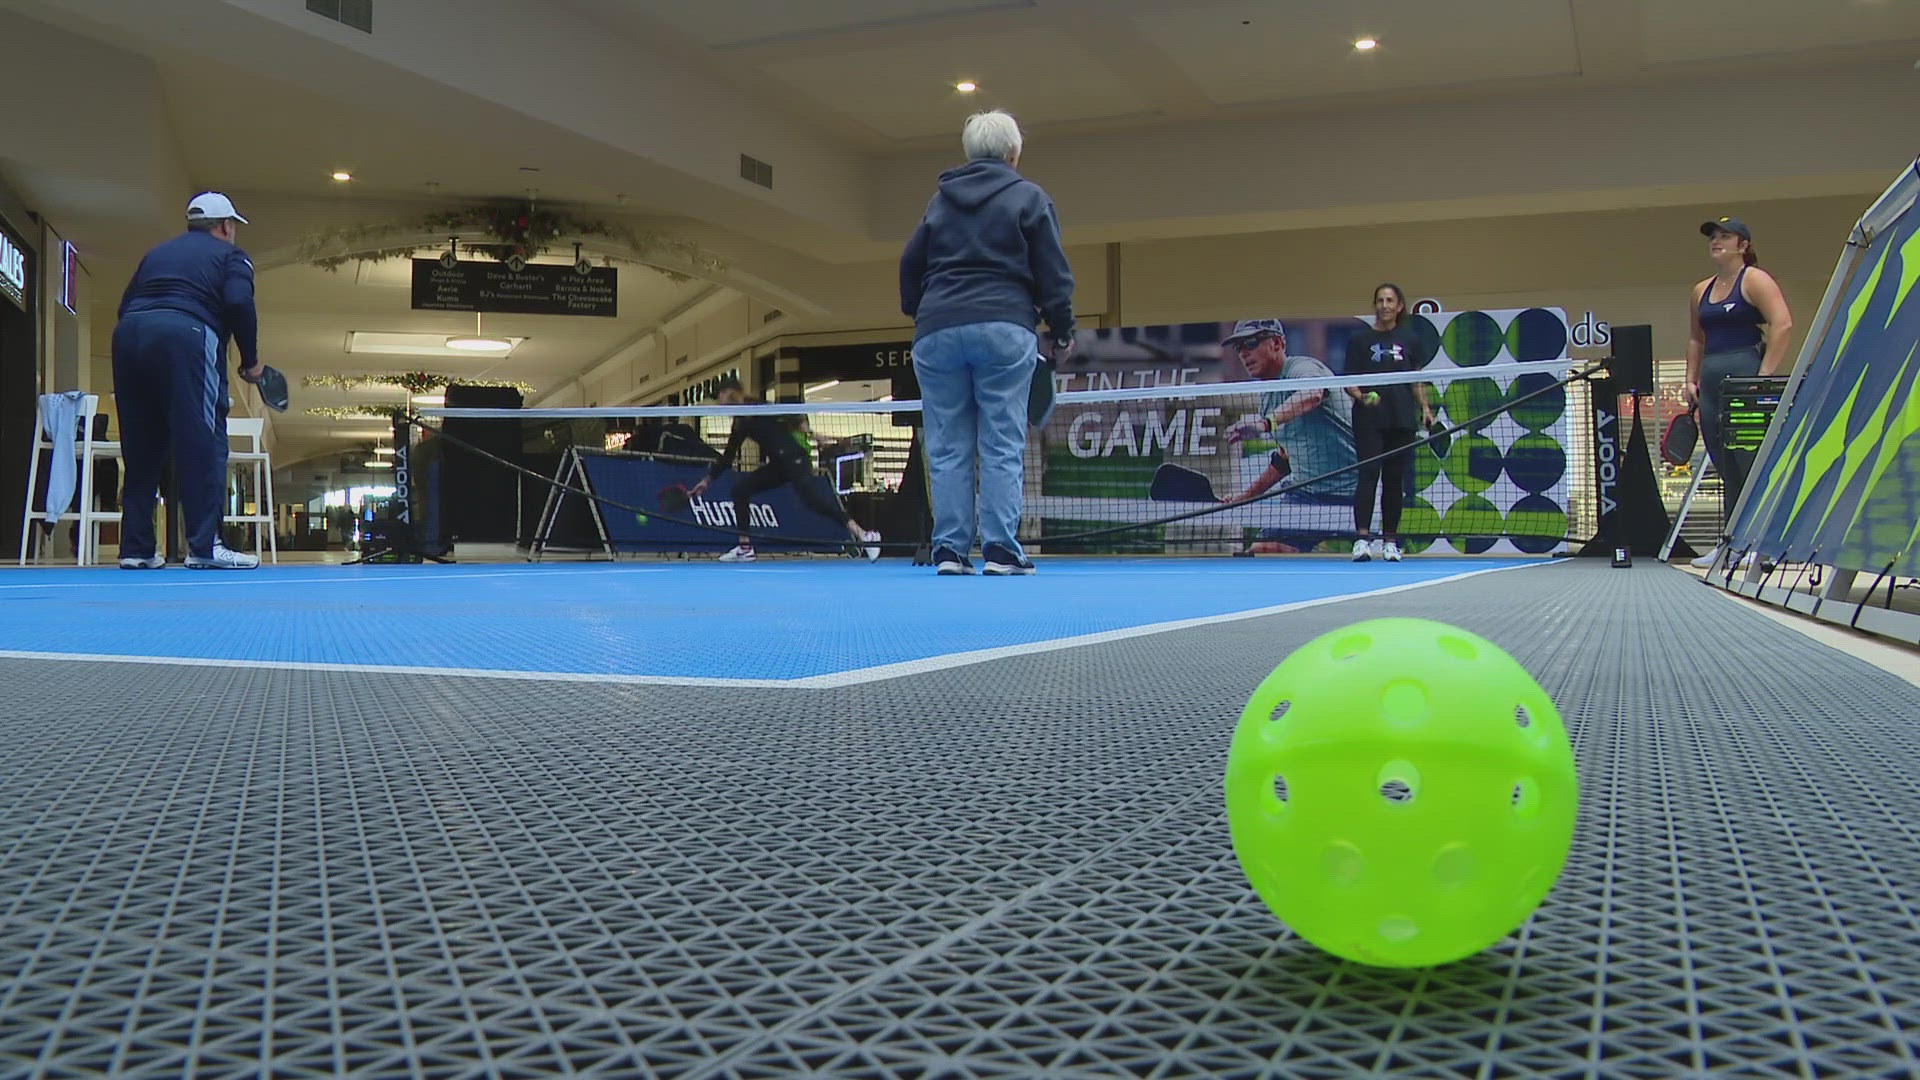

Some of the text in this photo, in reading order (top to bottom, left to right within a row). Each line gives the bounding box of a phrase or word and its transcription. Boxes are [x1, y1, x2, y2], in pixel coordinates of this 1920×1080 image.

[431, 268, 465, 278] Outdoor
[486, 272, 507, 280] Dave
[515, 273, 545, 282] Buster's
[569, 275, 605, 284] Play Area
[437, 285, 459, 293] Aerie
[499, 281, 532, 291] Carhartt
[555, 284, 581, 292] Barnes
[589, 285, 612, 294] Noble
[436, 294, 459, 302] Kumo
[479, 290, 495, 298] BJ's
[552, 293, 566, 301] The
[567, 294, 613, 303] Cheesecake
[567, 301, 597, 310] Factory
[1085, 370, 1124, 402] IN
[1132, 367, 1200, 401] THE
[1068, 408, 1221, 459] GAME
[1598, 426, 1617, 516] JOOLA
[396, 445, 408, 509] JOOLA
[689, 494, 779, 528] Humna
